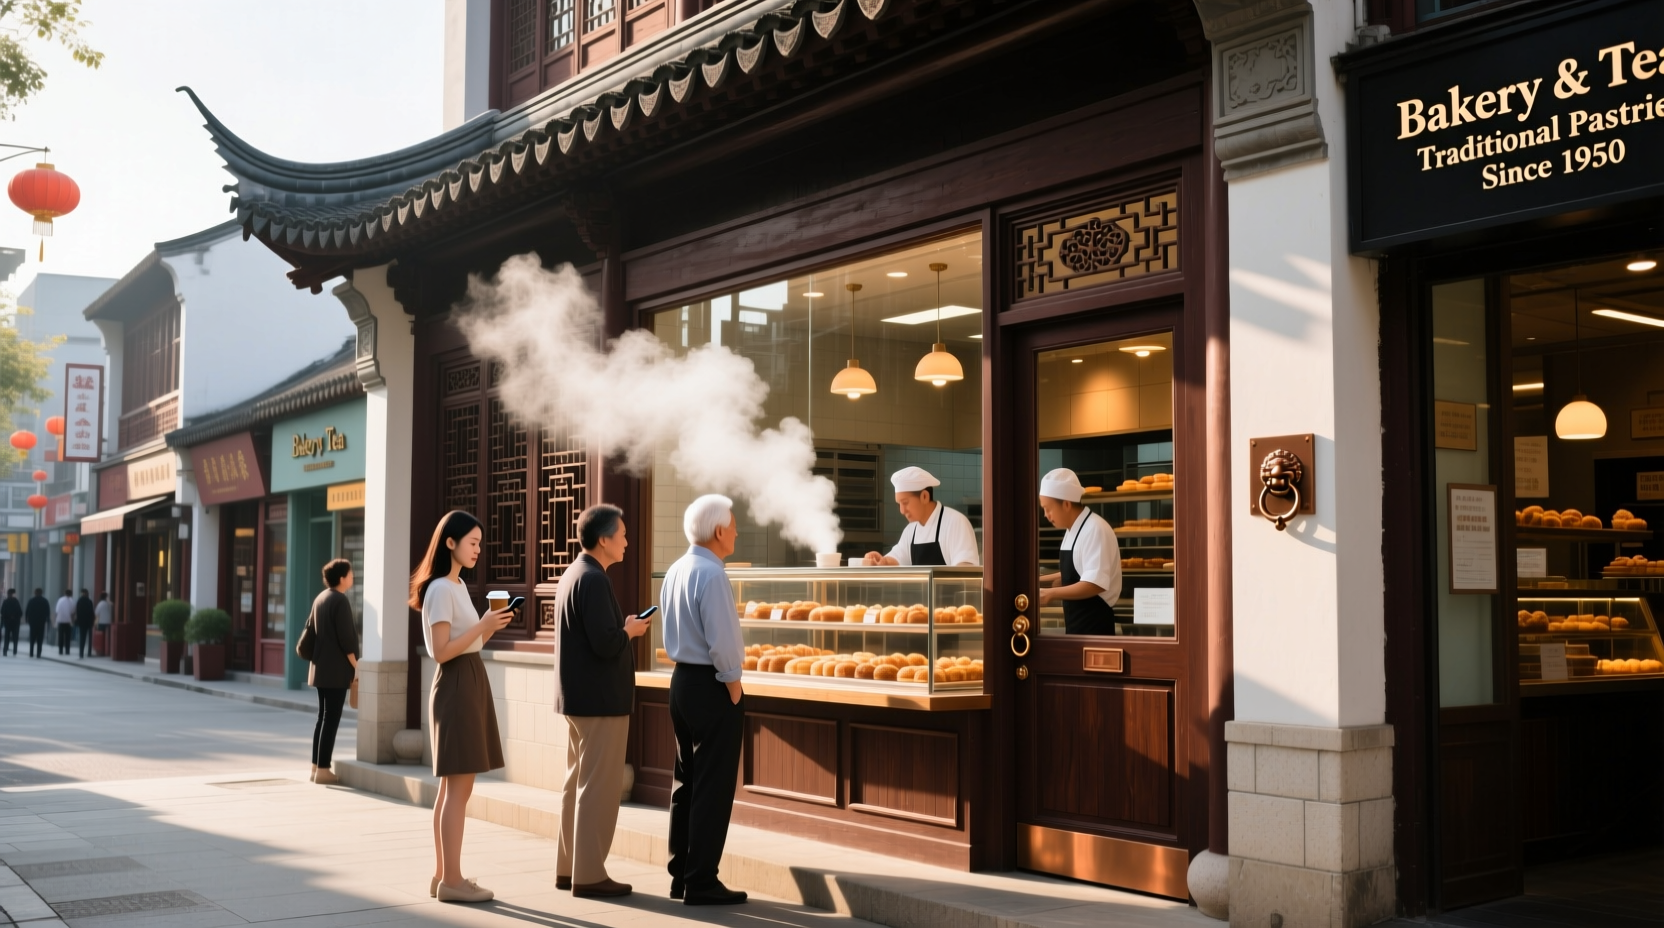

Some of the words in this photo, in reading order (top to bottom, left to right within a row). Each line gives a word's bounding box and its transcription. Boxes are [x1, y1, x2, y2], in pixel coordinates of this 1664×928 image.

[1396, 77, 1543, 140] Bakery
[1553, 58, 1591, 100] &
[1598, 40, 1664, 88] Te
[1416, 114, 1561, 171] Traditional
[1482, 160, 1553, 190] Since
[1561, 138, 1626, 174] 1950
[325, 426, 347, 451] Tea
